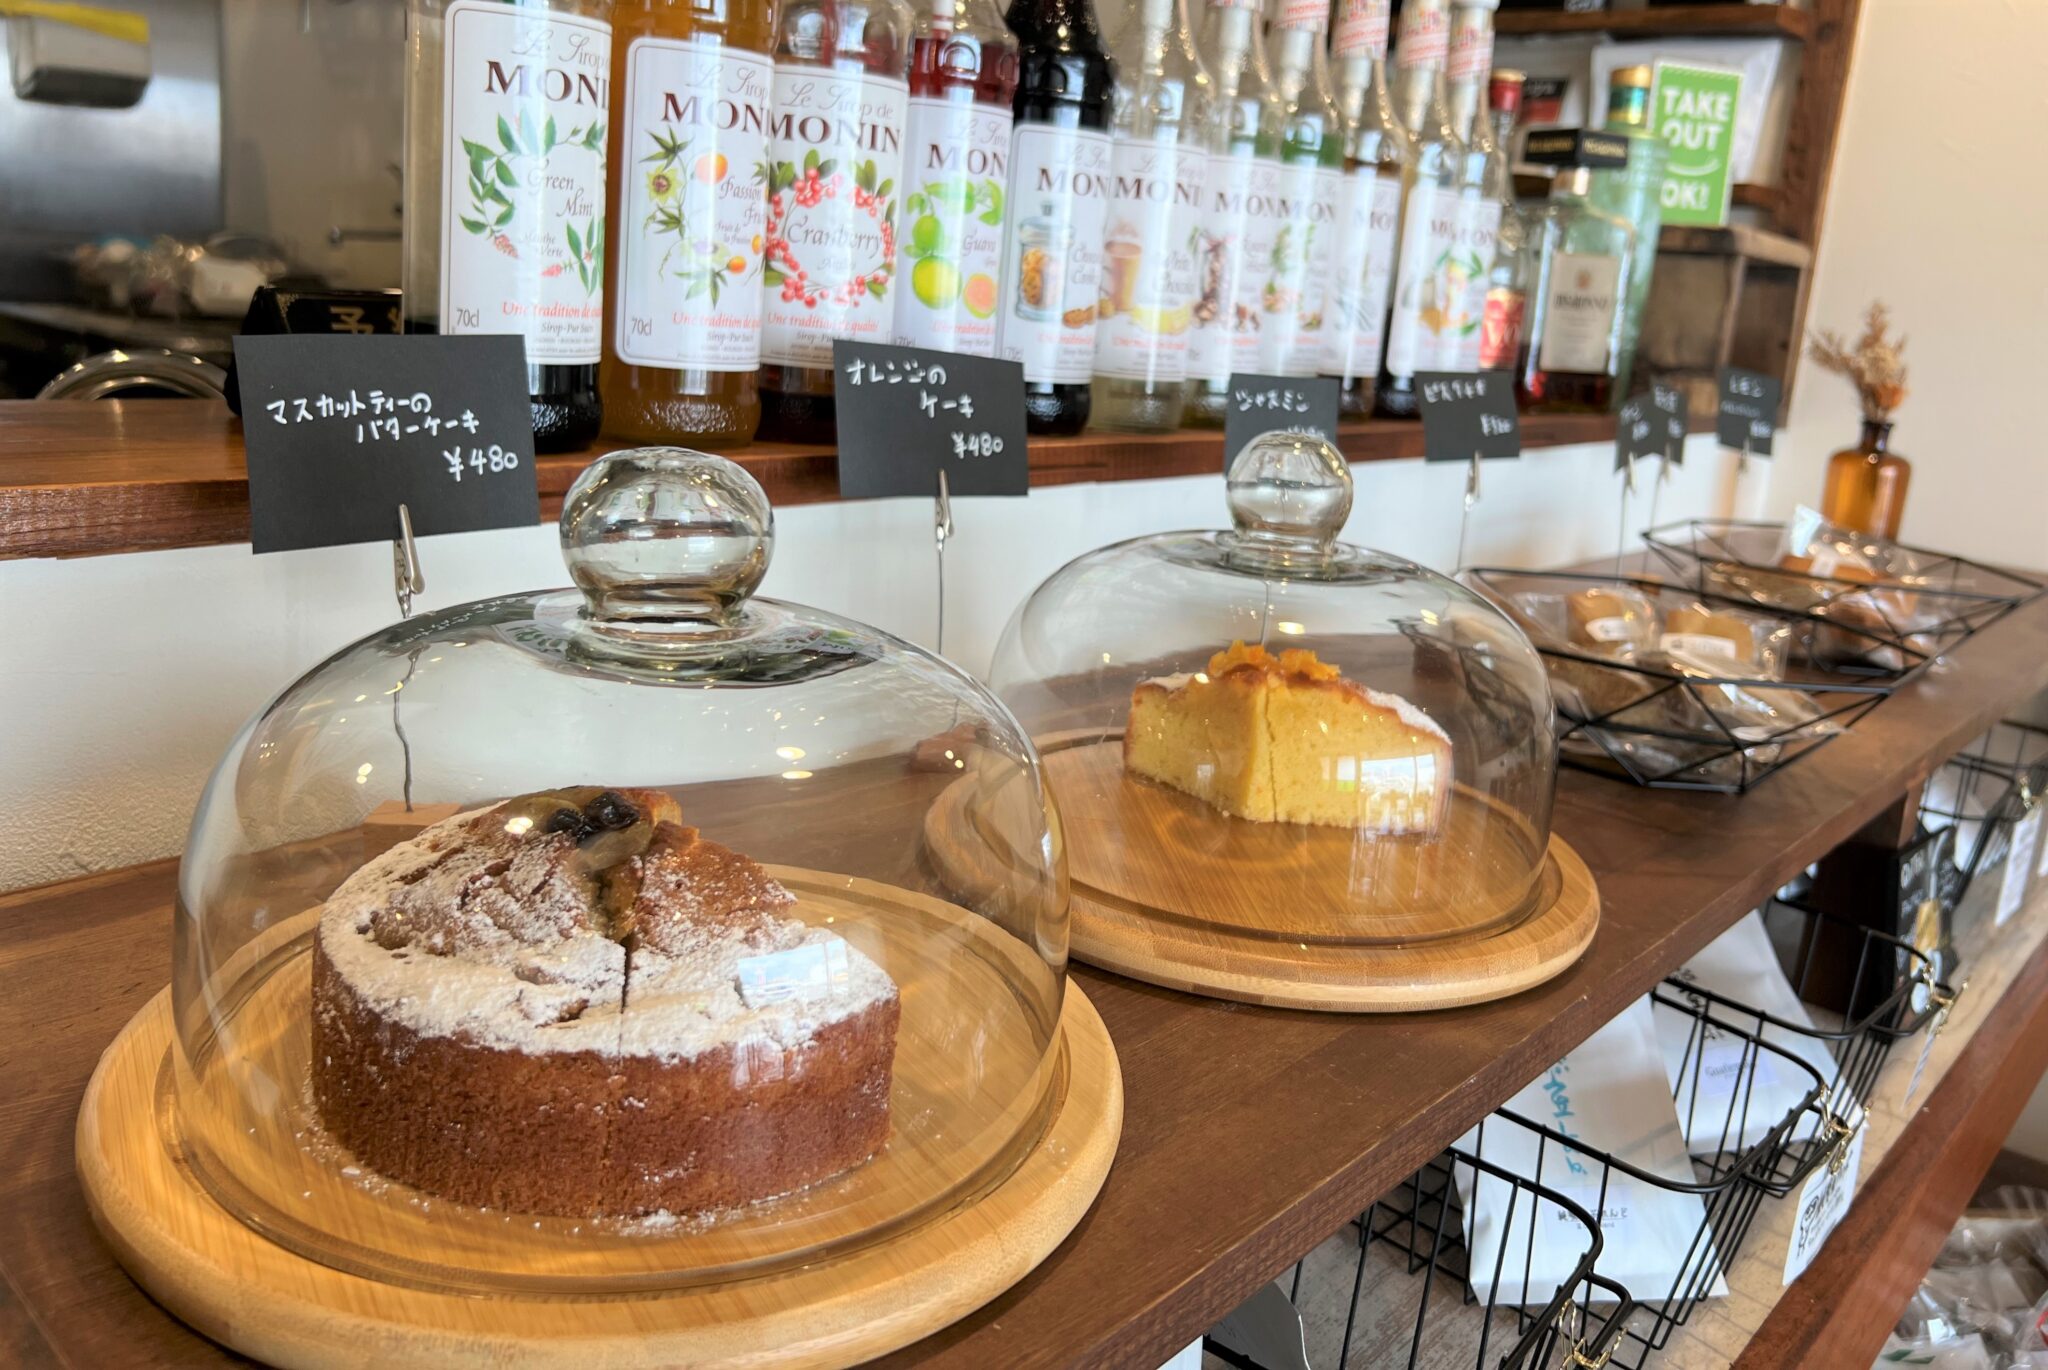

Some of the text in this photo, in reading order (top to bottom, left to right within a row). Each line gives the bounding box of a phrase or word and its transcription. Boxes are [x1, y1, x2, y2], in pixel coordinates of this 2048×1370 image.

[877, 103, 894, 119] de
[1662, 86, 1731, 121] TAKE
[771, 113, 901, 154] MONIN
[1662, 118, 1723, 150] OUT
[1660, 179, 1711, 210] OK!
[787, 215, 882, 260] Cranberry
[329, 306, 402, 335] 予
[456, 308, 479, 328] 70cl
[631, 317, 652, 336] 70cl
[846, 356, 947, 386] オレンジの
[266, 389, 433, 425] マスカットティーの
[919, 388, 974, 418] ケーキ
[1235, 386, 1311, 413] ジャスミン
[355, 409, 480, 444] バターケーキ
[951, 431, 1004, 459] ¥480
[442, 444, 519, 483] ¥480
